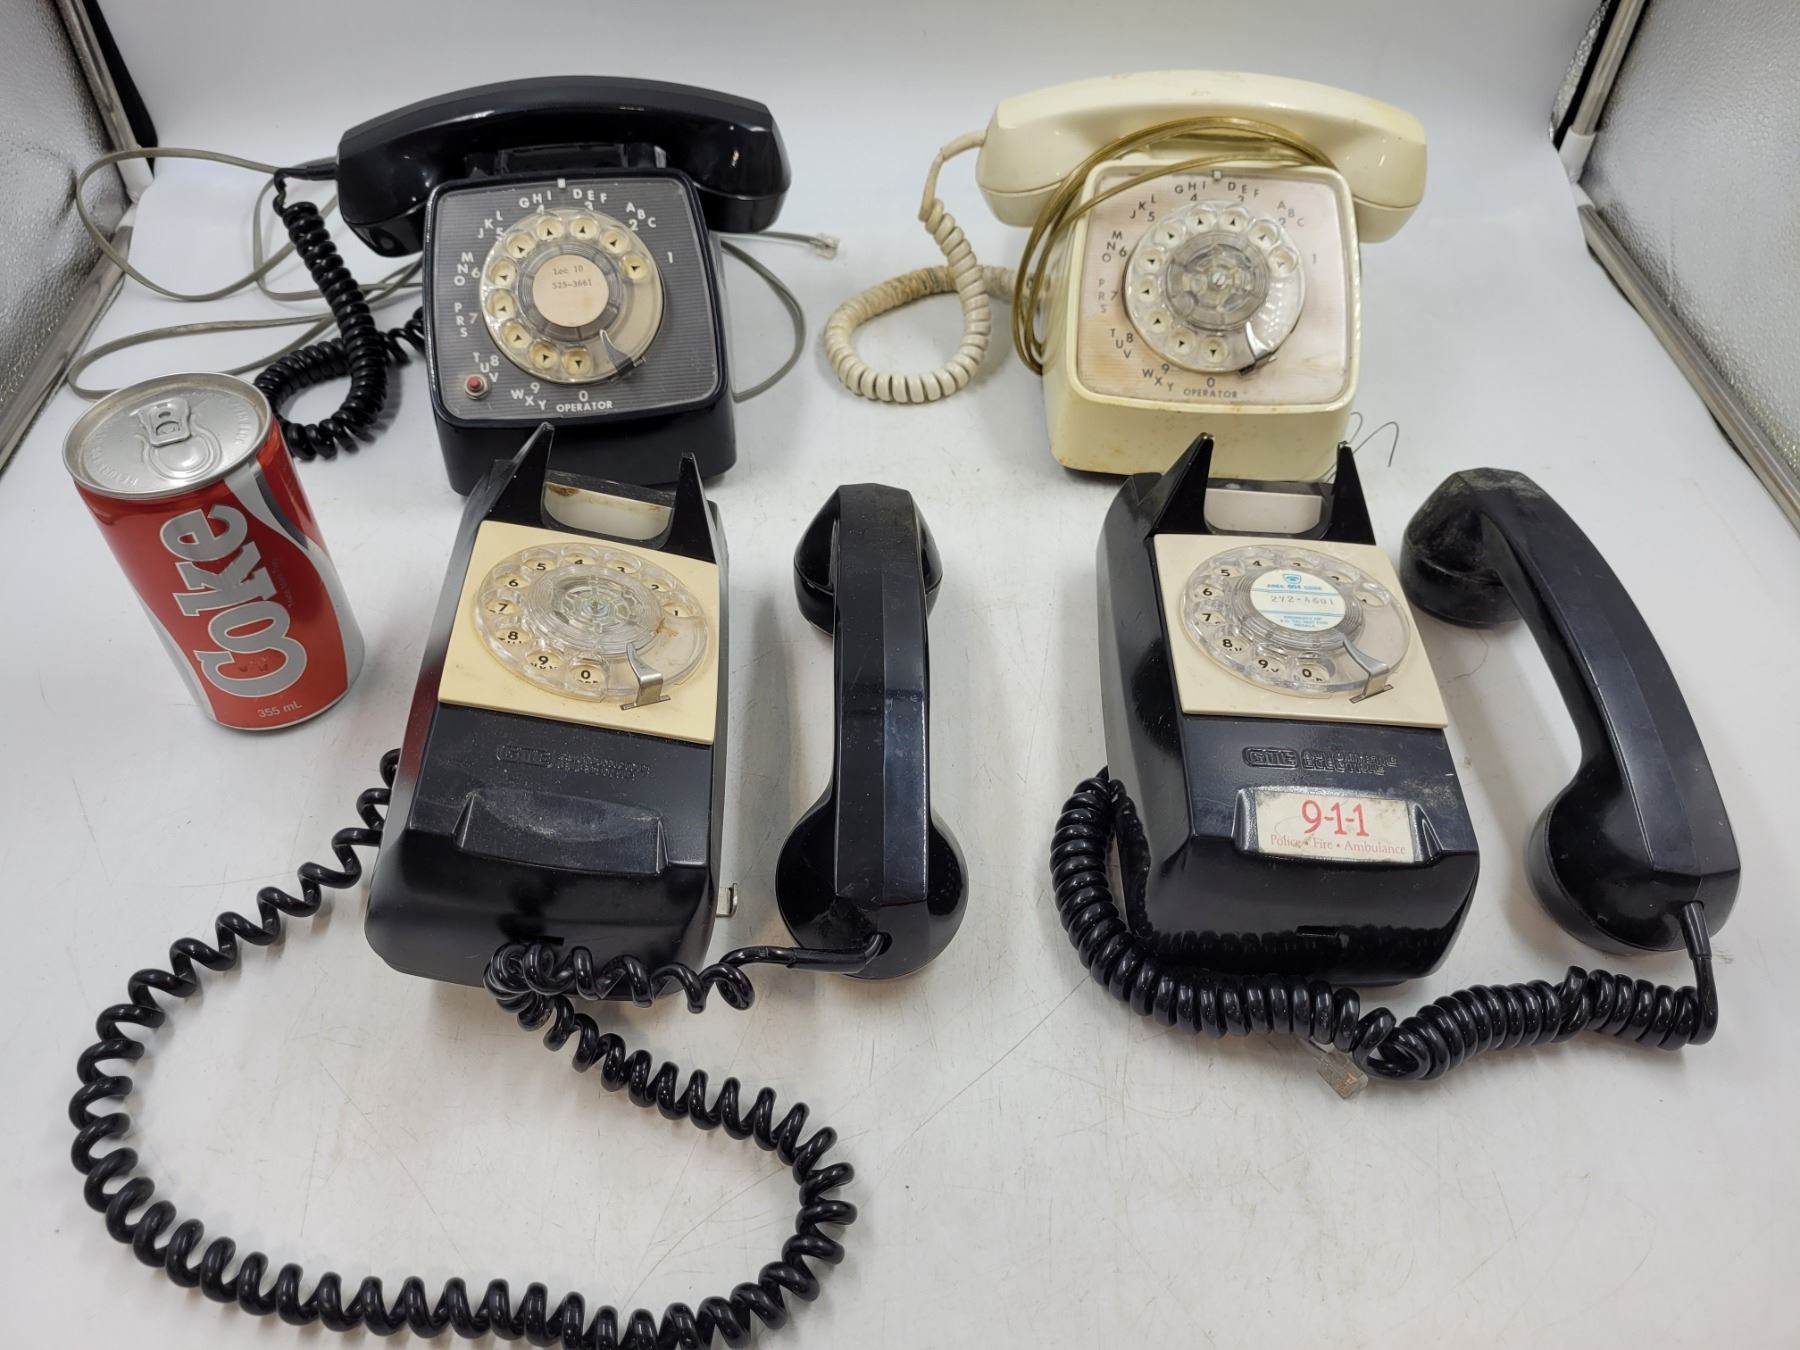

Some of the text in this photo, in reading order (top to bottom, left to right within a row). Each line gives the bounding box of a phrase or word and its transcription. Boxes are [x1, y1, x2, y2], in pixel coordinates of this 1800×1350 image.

[1147, 212, 1155, 223] 5
[628, 219, 638, 231] 2
[1119, 246, 1127, 258] 6
[471, 267, 480, 279] 6
[469, 313, 478, 325] 7
[1125, 332, 1134, 343] 8
[490, 355, 499, 367] 8
[1161, 363, 1170, 375] 9
[531, 383, 540, 394] 9
[1183, 387, 1238, 399] OPERATOR
[556, 401, 613, 412] OPERATOR
[536, 562, 546, 571] 5
[1221, 569, 1230, 577] 5
[508, 578, 519, 587] 6
[1202, 587, 1213, 597] 6
[160, 504, 307, 698] Coke
[498, 603, 508, 612] 7
[1202, 613, 1211, 622] 7
[508, 631, 518, 641] 8
[1222, 639, 1233, 648] 8
[538, 656, 549, 665] 9
[1258, 659, 1269, 669] 9
[580, 669, 591, 680] 0
[1301, 668, 1312, 678] 0
[257, 700, 303, 718] 355 mL
[1302, 799, 1370, 837] 9-1-1
[1270, 834, 1407, 855] Police Fire Ambulance
